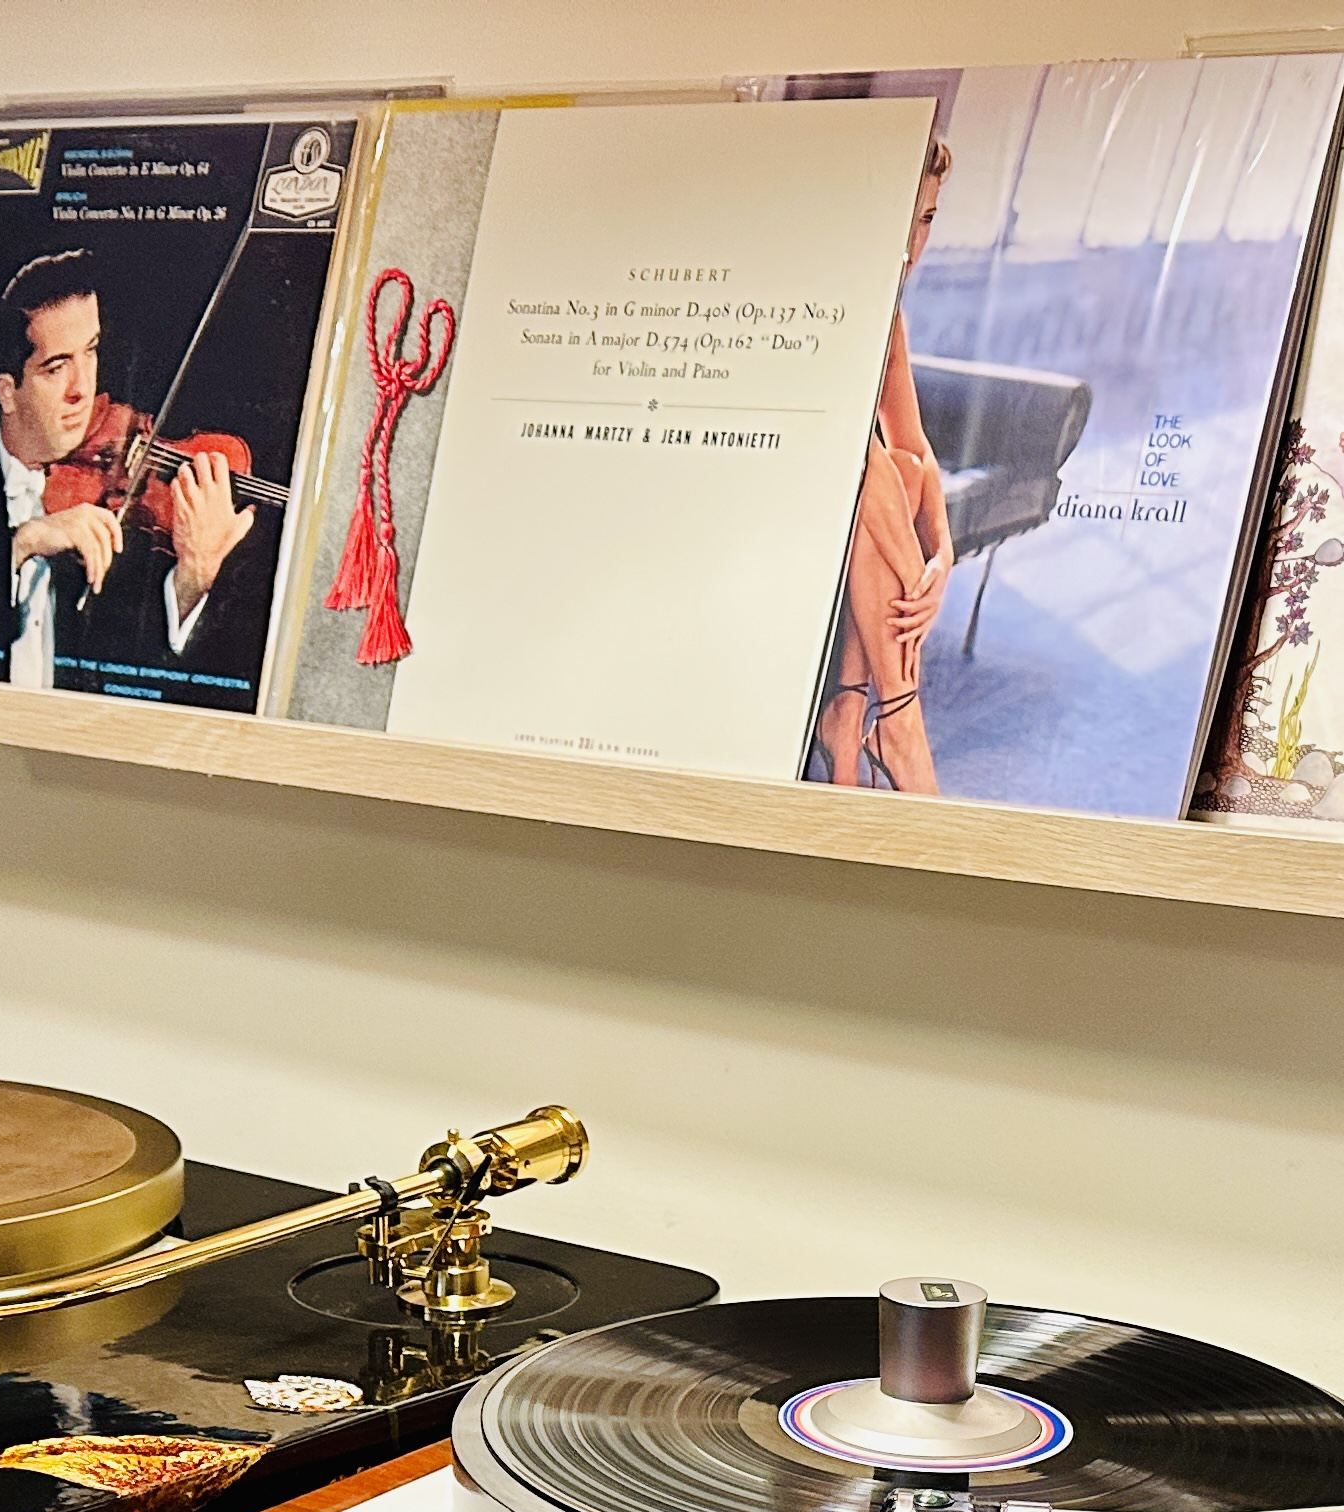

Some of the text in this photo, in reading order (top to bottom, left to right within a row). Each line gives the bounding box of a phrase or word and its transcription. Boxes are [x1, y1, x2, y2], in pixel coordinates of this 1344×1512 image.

[627, 267, 732, 283] SCHUBERT
[507, 299, 561, 316] Sonatina
[605, 302, 618, 317] in
[623, 302, 635, 317] G
[640, 303, 681, 318] minor
[520, 329, 563, 346] Sonata
[568, 330, 581, 346] in
[585, 330, 597, 346] A
[601, 332, 641, 350] major
[592, 360, 730, 380] for Violin and Piano
[1154, 414, 1183, 430] THE
[521, 423, 782, 450] JOHANNA MARTZY & JEAN ANTONIETTI
[1148, 432, 1193, 449] LOOK
[1144, 452, 1168, 467] OF
[1140, 471, 1181, 487] LOVE
[1057, 494, 1187, 523] diana krall
